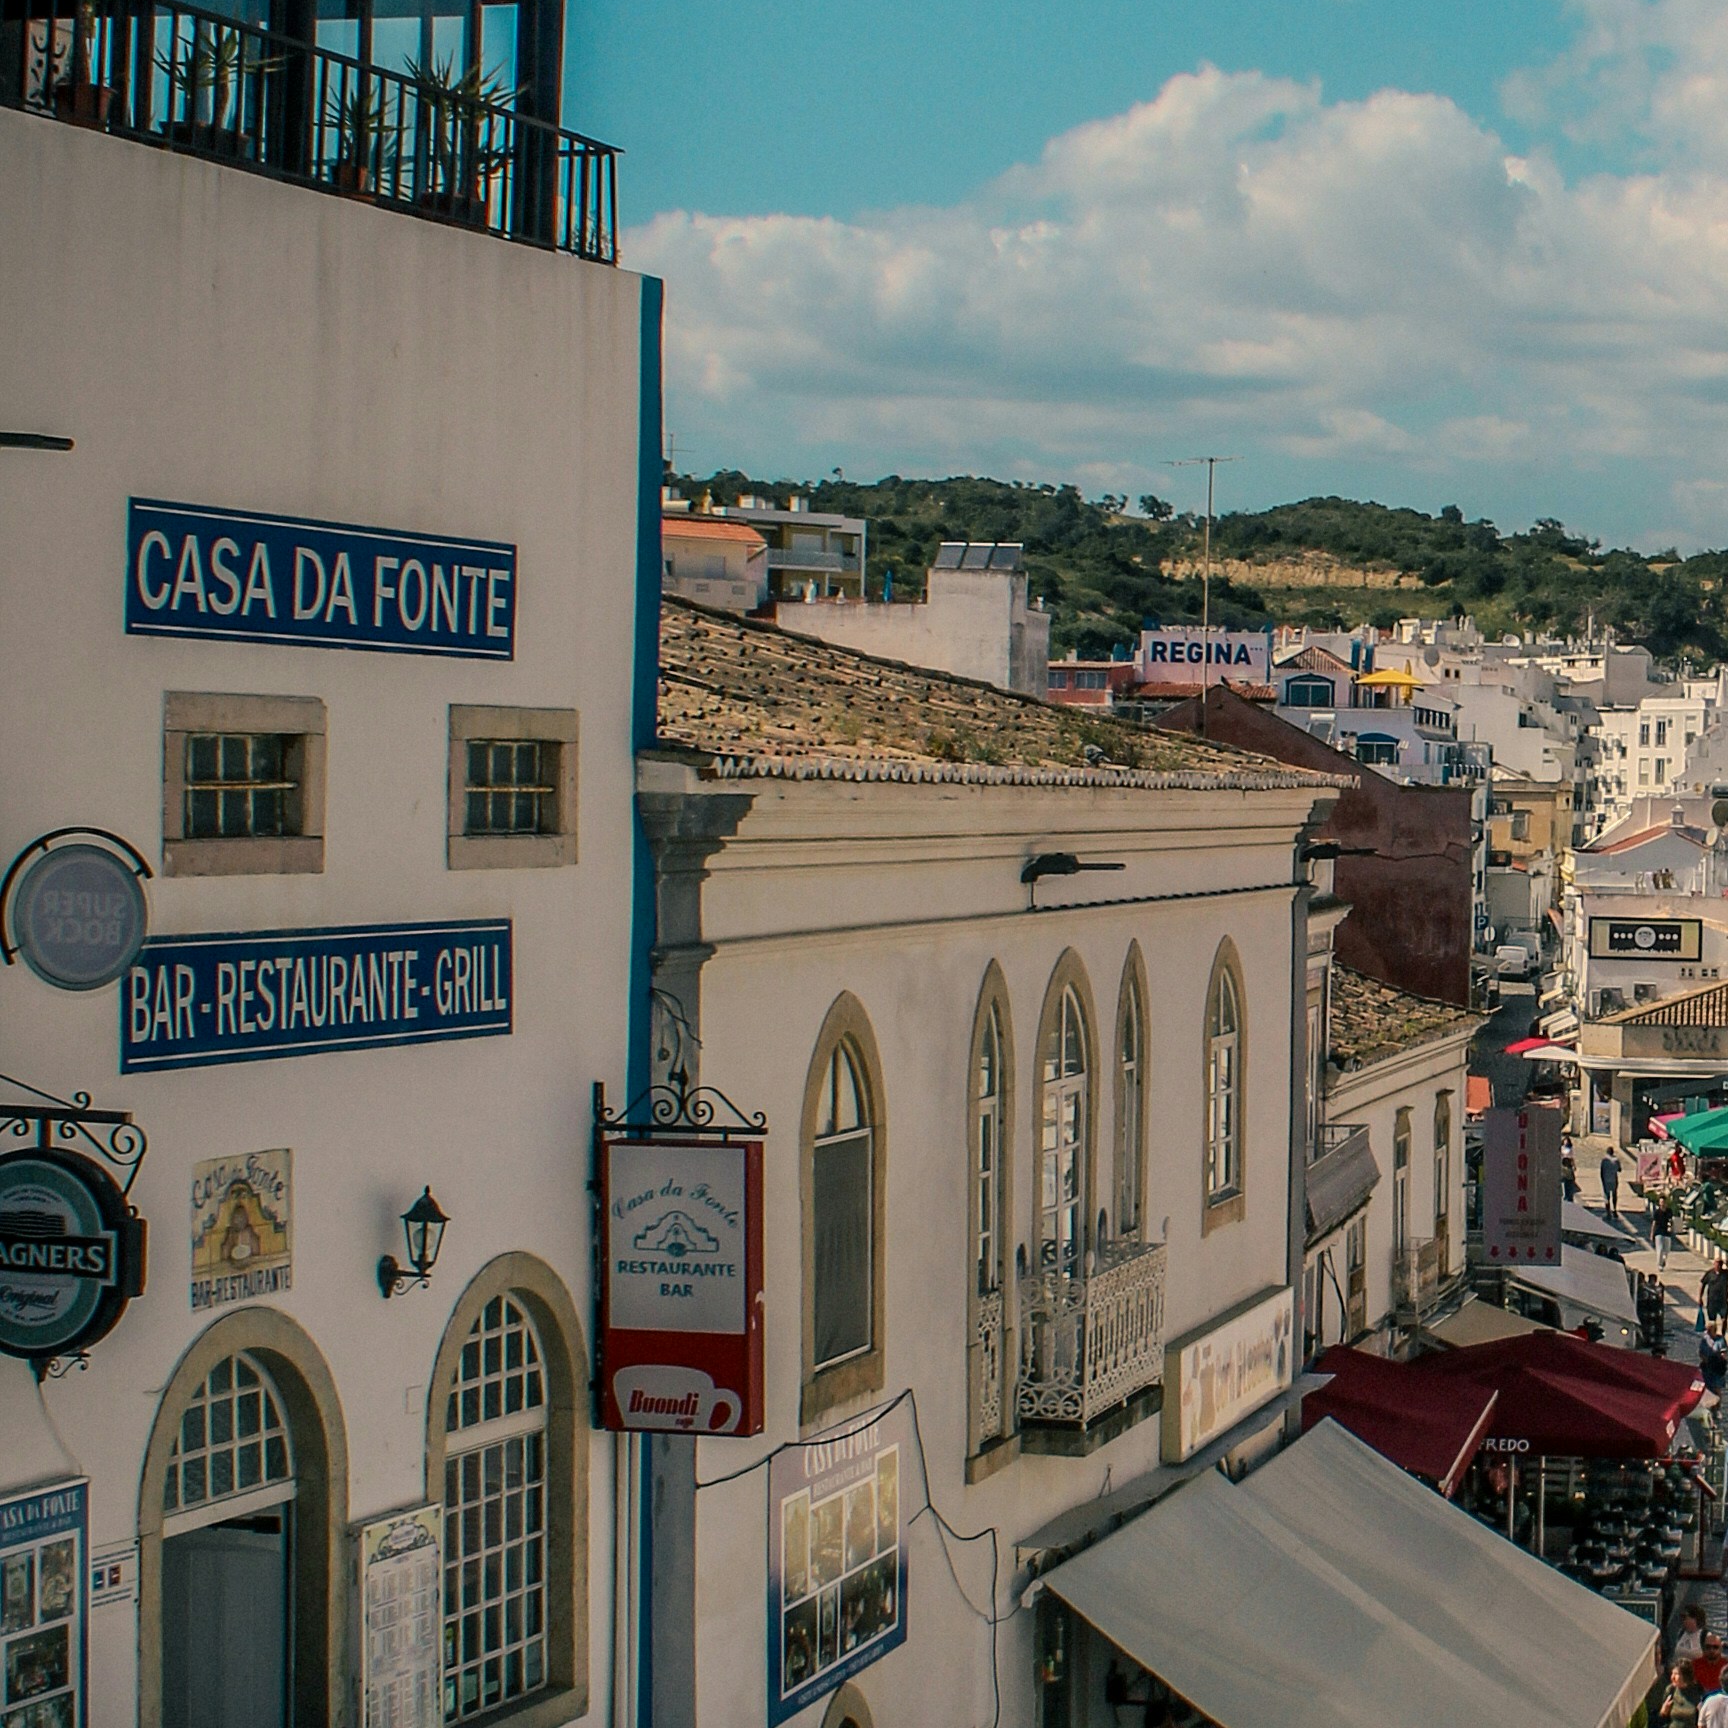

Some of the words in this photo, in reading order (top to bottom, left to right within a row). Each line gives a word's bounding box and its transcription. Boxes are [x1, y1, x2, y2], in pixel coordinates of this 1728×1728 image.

[137, 530, 276, 620] CASA
[293, 546, 358, 627] DA
[373, 555, 511, 638] FONTE
[1151, 641, 1252, 665] REGINA
[611, 1186, 654, 1220] Casa
[660, 1177, 683, 1197] da
[690, 1183, 740, 1229] Fonte
[617, 1259, 736, 1278] RESTAURANTE
[659, 1283, 694, 1298] BAR
[629, 1389, 699, 1417] Buondi
